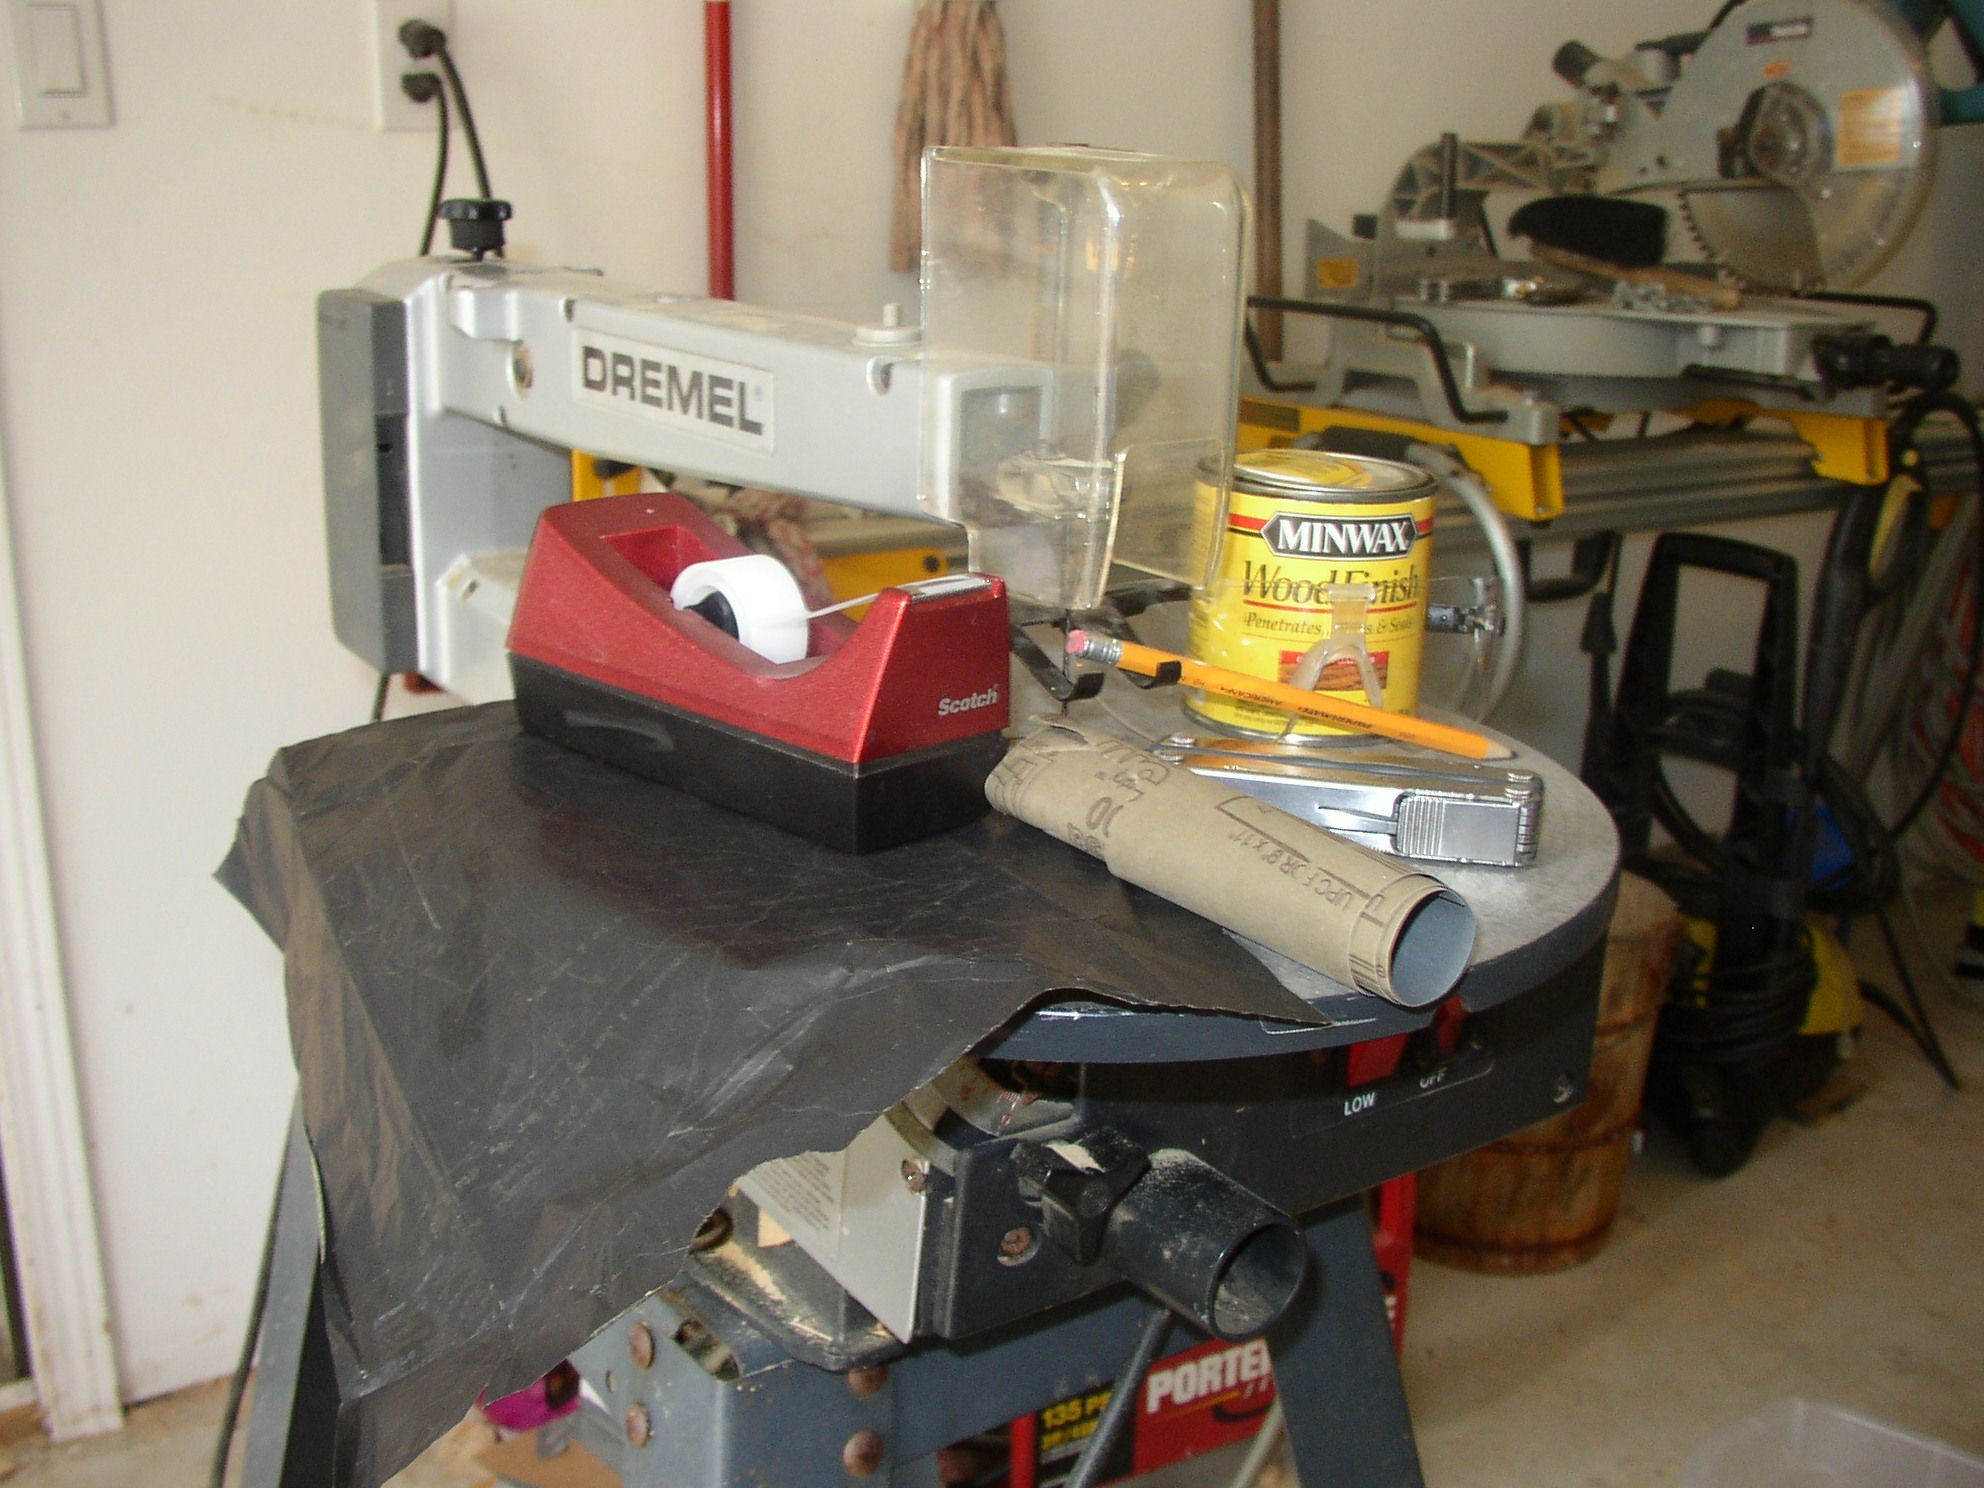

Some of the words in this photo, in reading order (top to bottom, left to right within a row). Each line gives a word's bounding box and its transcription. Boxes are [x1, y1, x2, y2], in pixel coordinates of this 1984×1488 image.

[582, 345, 762, 436] DREMEL
[1277, 518, 1408, 554] MINWAX
[1242, 560, 1339, 604] Wood
[938, 688, 998, 716] Scotch
[1314, 878, 1353, 911] UPC
[1344, 1091, 1377, 1117] LOW
